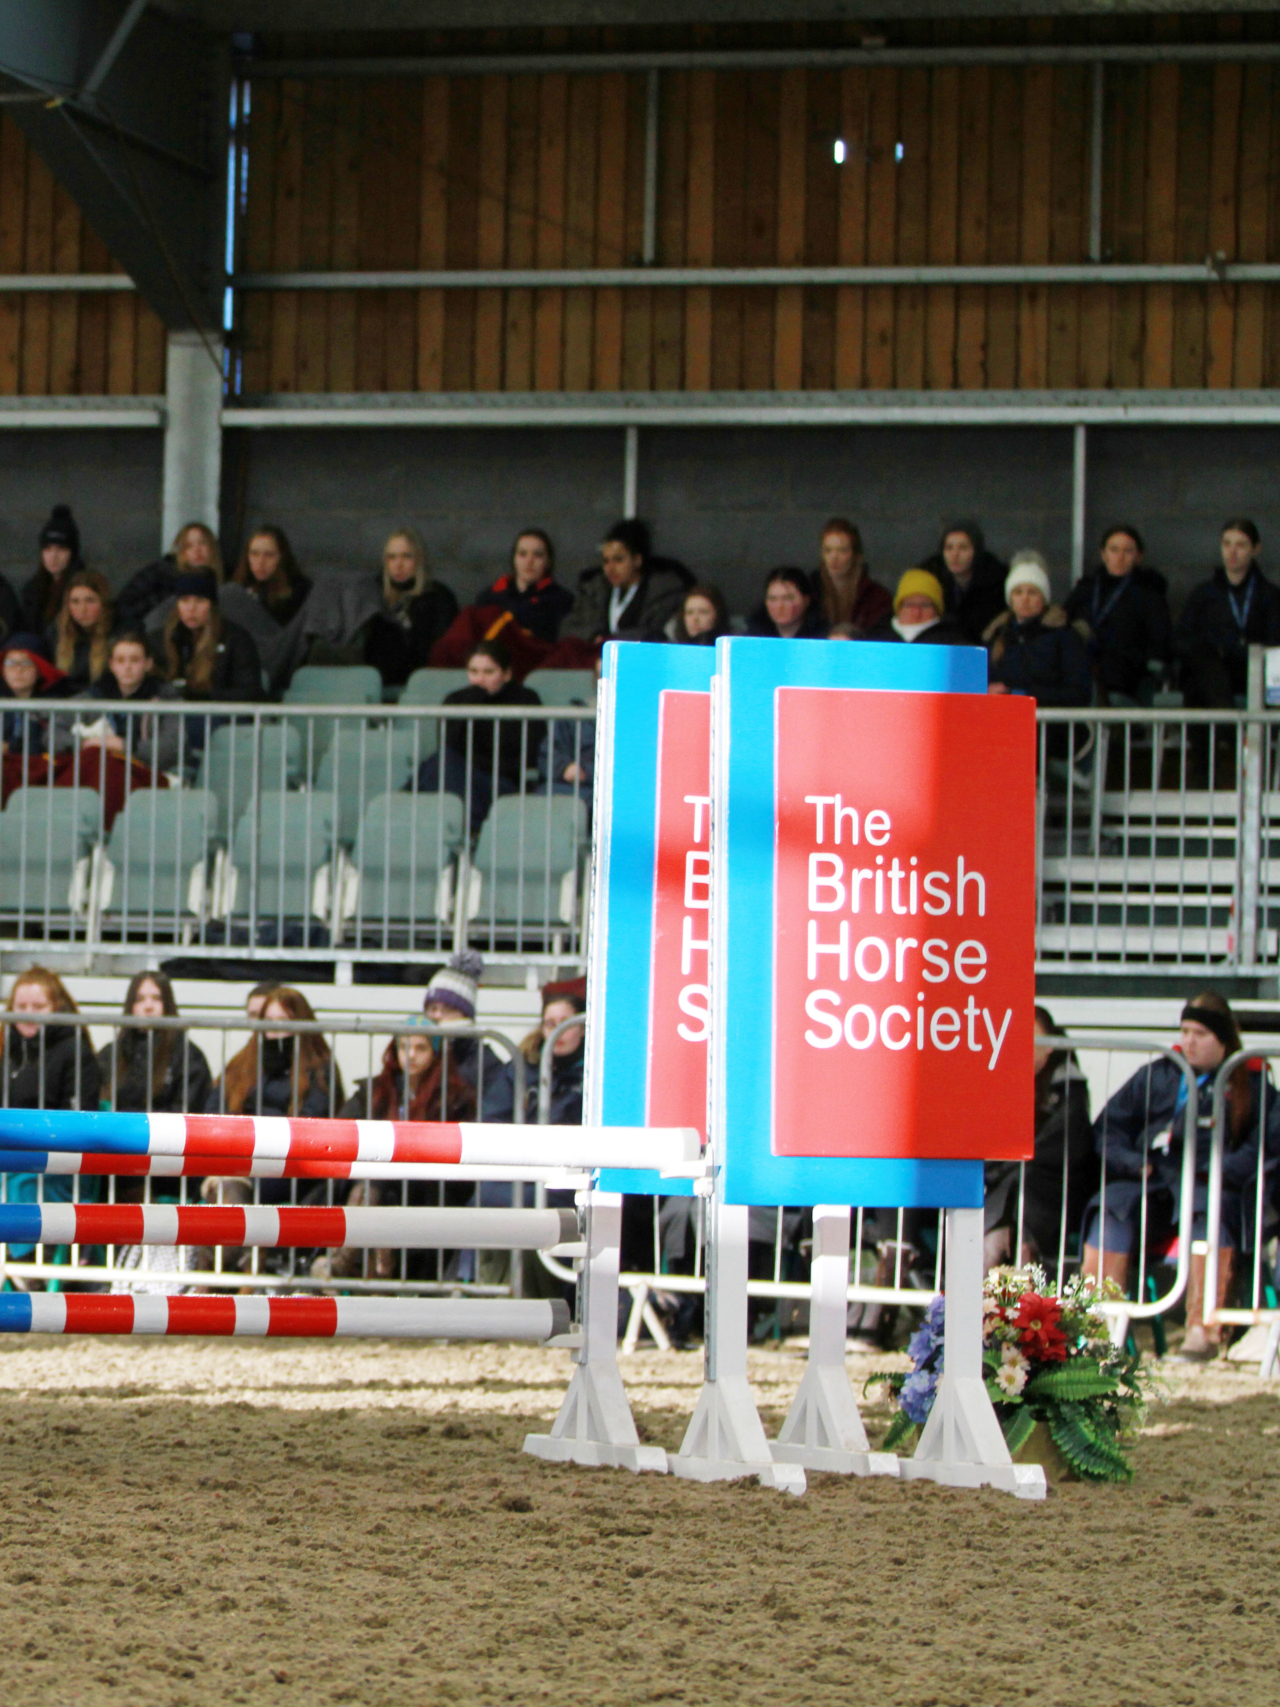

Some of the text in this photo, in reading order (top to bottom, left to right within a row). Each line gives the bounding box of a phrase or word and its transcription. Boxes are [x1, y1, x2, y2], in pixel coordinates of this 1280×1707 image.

[804, 793, 891, 846] The
[808, 852, 986, 917] British
[807, 918, 988, 984] Horse
[804, 988, 1013, 1071] Society
